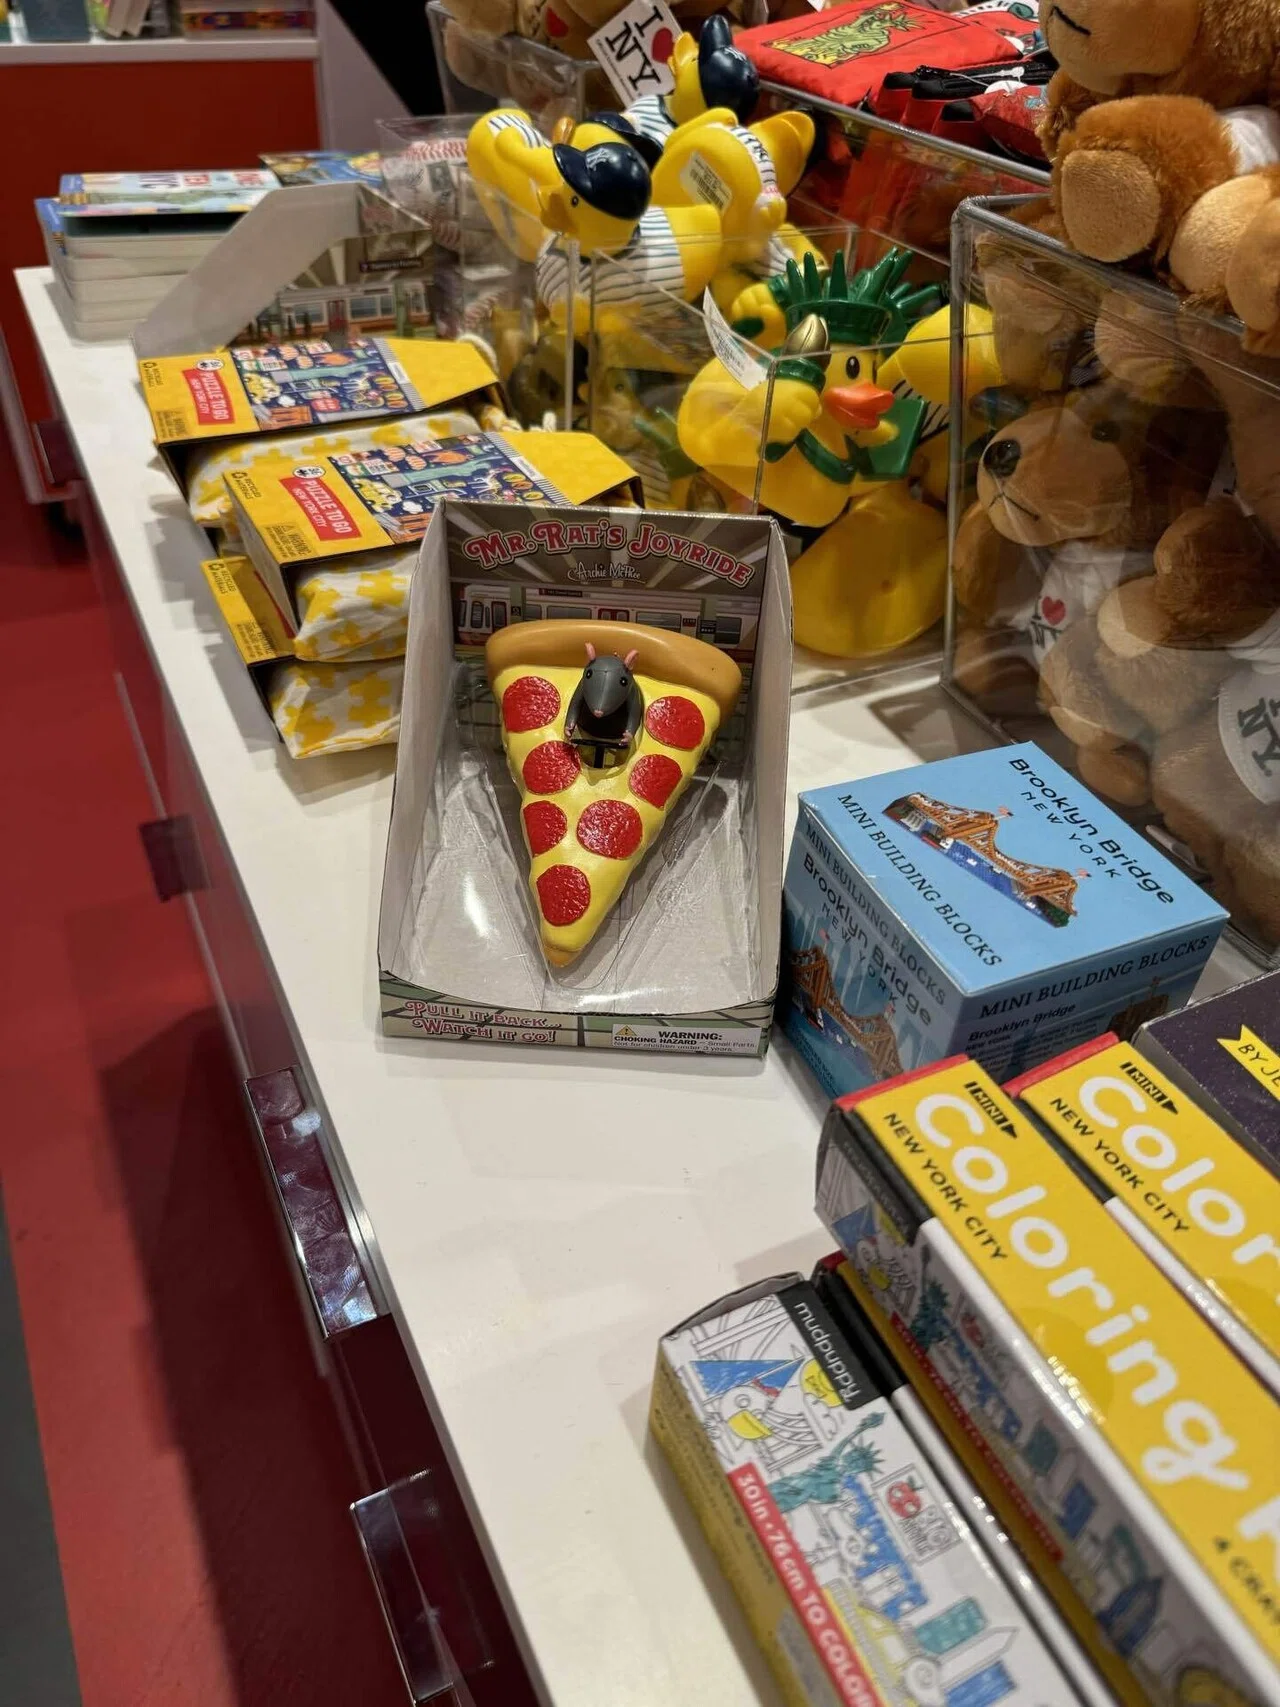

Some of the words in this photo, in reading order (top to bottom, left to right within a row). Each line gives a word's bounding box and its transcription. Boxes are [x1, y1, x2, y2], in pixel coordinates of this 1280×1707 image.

[634, 5, 663, 38] I
[605, 21, 661, 91] NY
[292, 487, 309, 501] NEW
[303, 500, 320, 515] YORK
[312, 514, 328, 527] CITY
[301, 480, 338, 510] PUZZLE
[326, 509, 345, 521] TO
[331, 520, 353, 534] GO
[463, 531, 535, 570] MR.
[532, 518, 627, 555] RAT'S
[628, 523, 755, 588] JOYRIDE
[567, 562, 607, 581] Archie
[214, 572, 229, 595] MATERIALS
[221, 570, 237, 592] RECYCLED
[1009, 758, 1098, 836] Brooklyn
[1098, 838, 1174, 904] Bridge
[1020, 791, 1064, 825] NEW
[1068, 833, 1122, 879] YORK
[838, 794, 876, 836] MINI
[869, 827, 942, 902] BUILDING
[934, 903, 1003, 966] BLOCKS
[806, 823, 831, 864] MINI
[831, 857, 889, 938] BUILDING
[890, 935, 947, 1006] BLOCKS
[803, 852, 869, 948] Brooklyn
[871, 945, 932, 1026] Bridge
[821, 903, 852, 944] NEW
[858, 951, 898, 1007] YORK
[979, 991, 1035, 1019] MINI
[1037, 960, 1134, 1001] BUILDING
[1138, 935, 1210, 970] BLOCKS
[405, 1000, 464, 1020] PULL
[468, 1010, 489, 1022] IT
[412, 1018, 492, 1038] WATCH
[498, 1030, 517, 1042] IT
[520, 1030, 556, 1043] GO!
[968, 1018, 1030, 1042] Brooklyn
[1033, 1003, 1077, 1024] Bridge
[614, 1036, 657, 1044] CHOKING
[659, 1038, 697, 1046] HAZARD
[658, 1031, 723, 1041] WARNING:
[1238, 1044, 1268, 1061] BY
[1129, 1070, 1163, 1099] MINI
[972, 1090, 1005, 1122] MINI
[1050, 1097, 1094, 1137] NEW
[1093, 1139, 1145, 1190] YORK
[1143, 1192, 1191, 1233] CITY
[883, 1113, 925, 1155] NEW
[921, 1158, 968, 1213] YORK
[964, 1215, 1009, 1261] CITY
[915, 1093, 1250, 1490] Coloring
[794, 1301, 862, 1403] mudpuppy
[767, 1530, 792, 1559] 76
[782, 1557, 805, 1591] cm
[801, 1590, 827, 1626] TO
